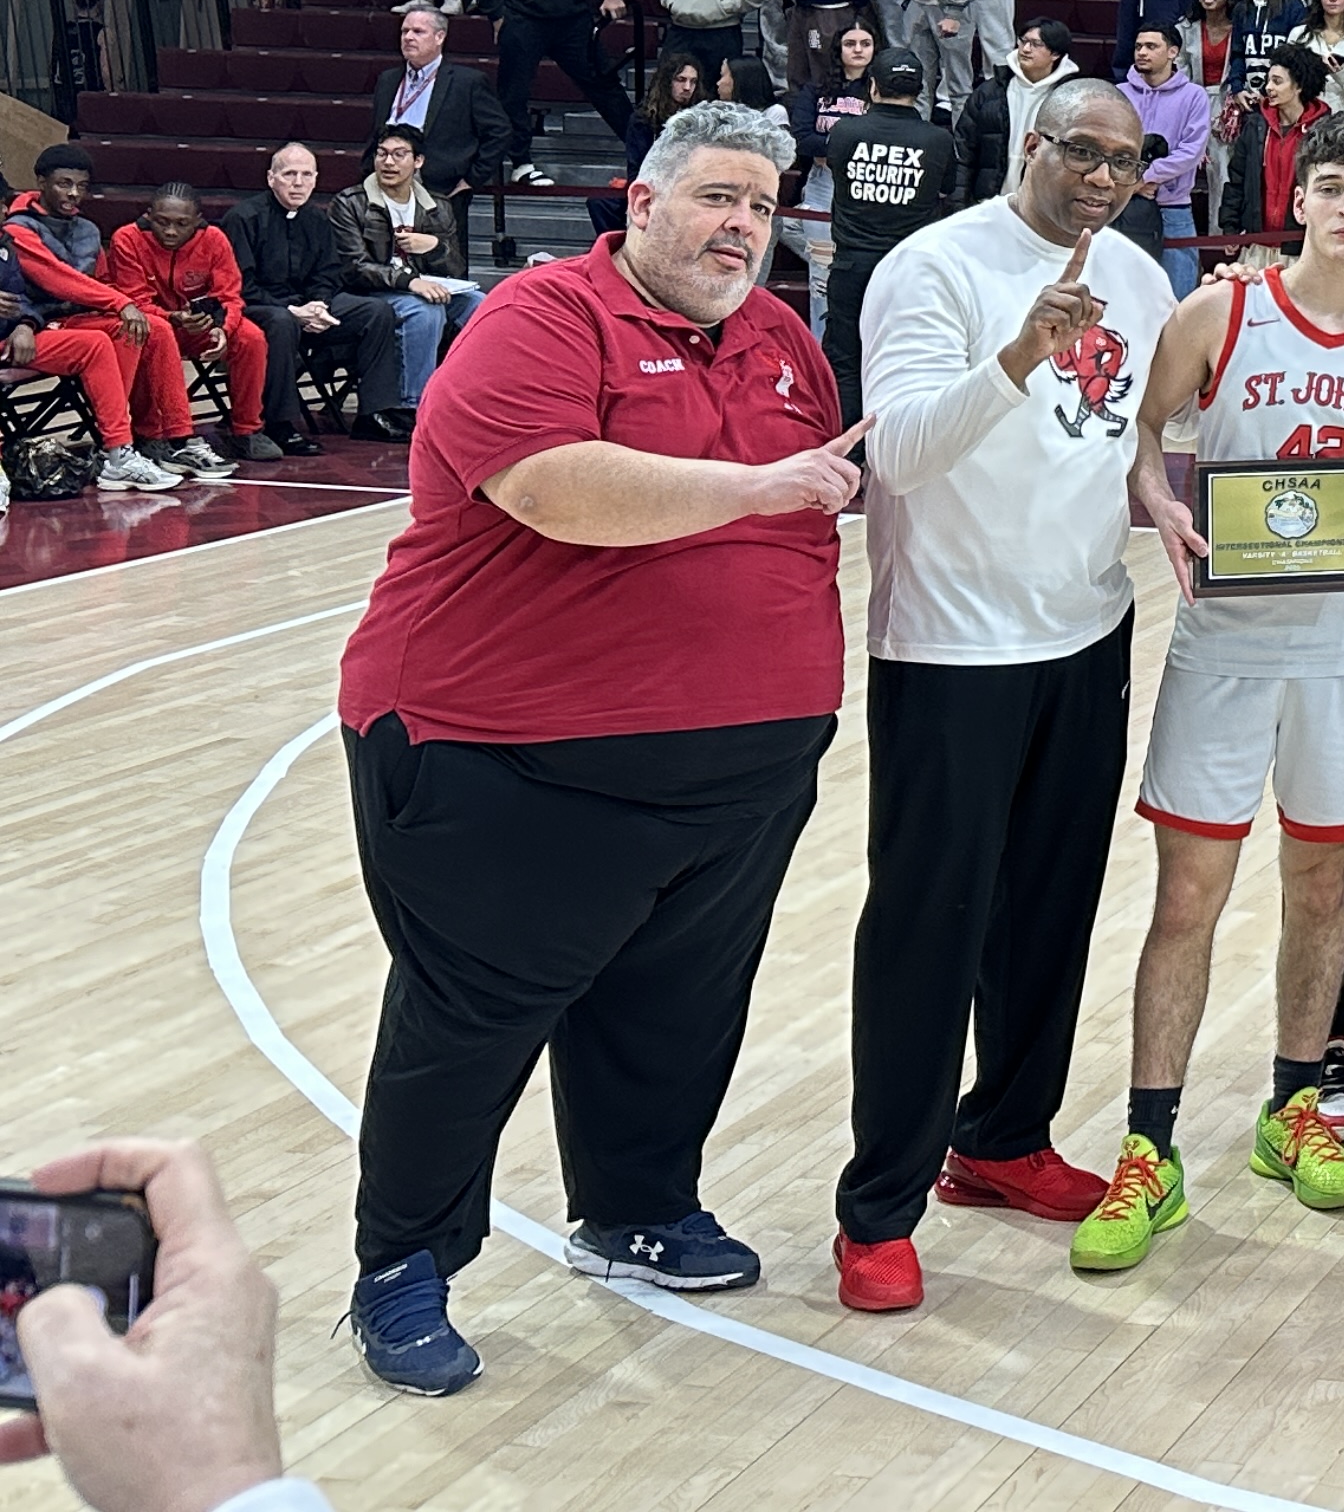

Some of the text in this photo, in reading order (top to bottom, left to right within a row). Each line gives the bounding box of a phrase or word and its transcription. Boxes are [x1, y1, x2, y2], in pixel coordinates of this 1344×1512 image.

[852, 142, 923, 167] APEX
[847, 161, 924, 187] SECURITY
[851, 181, 916, 205] GROUP
[640, 358, 684, 374] COACH
[1243, 371, 1287, 411] ST.
[1262, 477, 1321, 492] CHSAA
